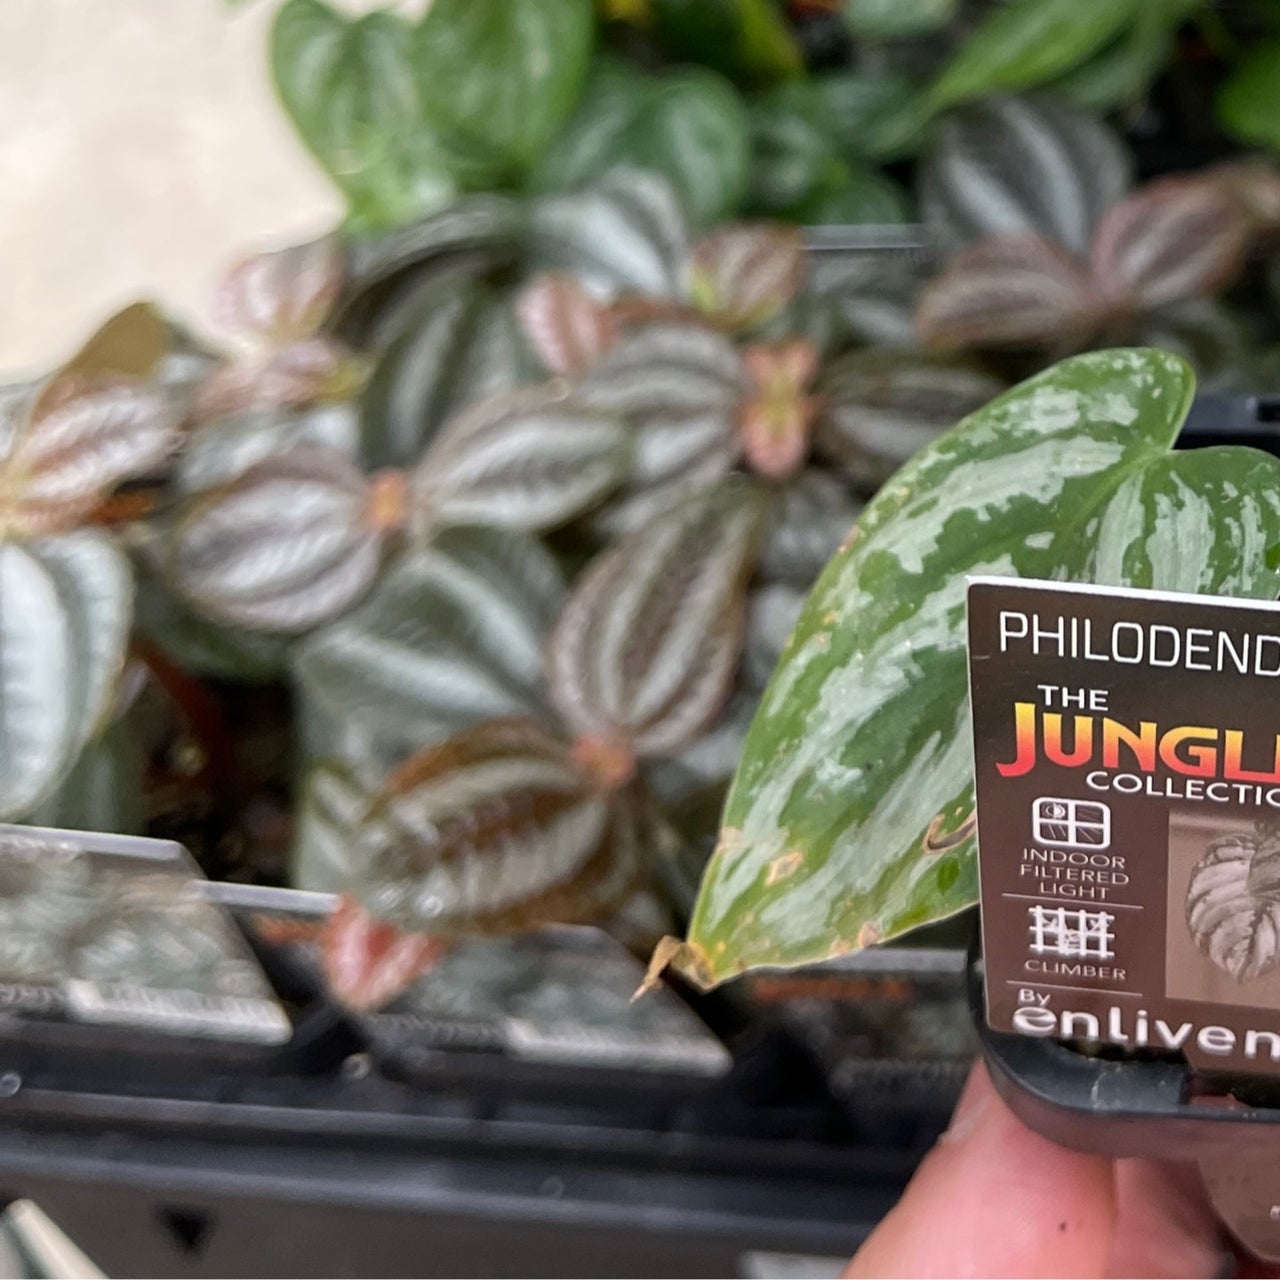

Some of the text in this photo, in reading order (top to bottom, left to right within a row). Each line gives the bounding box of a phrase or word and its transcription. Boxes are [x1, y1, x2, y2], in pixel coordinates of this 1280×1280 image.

[1037, 684, 1109, 711] THE
[1023, 848, 1126, 869] INDOOR
[1020, 865, 1130, 885] FILTERED
[1040, 882, 1110, 900] LIGHT
[1024, 959, 1126, 980] CLIMBER
[1018, 988, 1051, 1007] By
